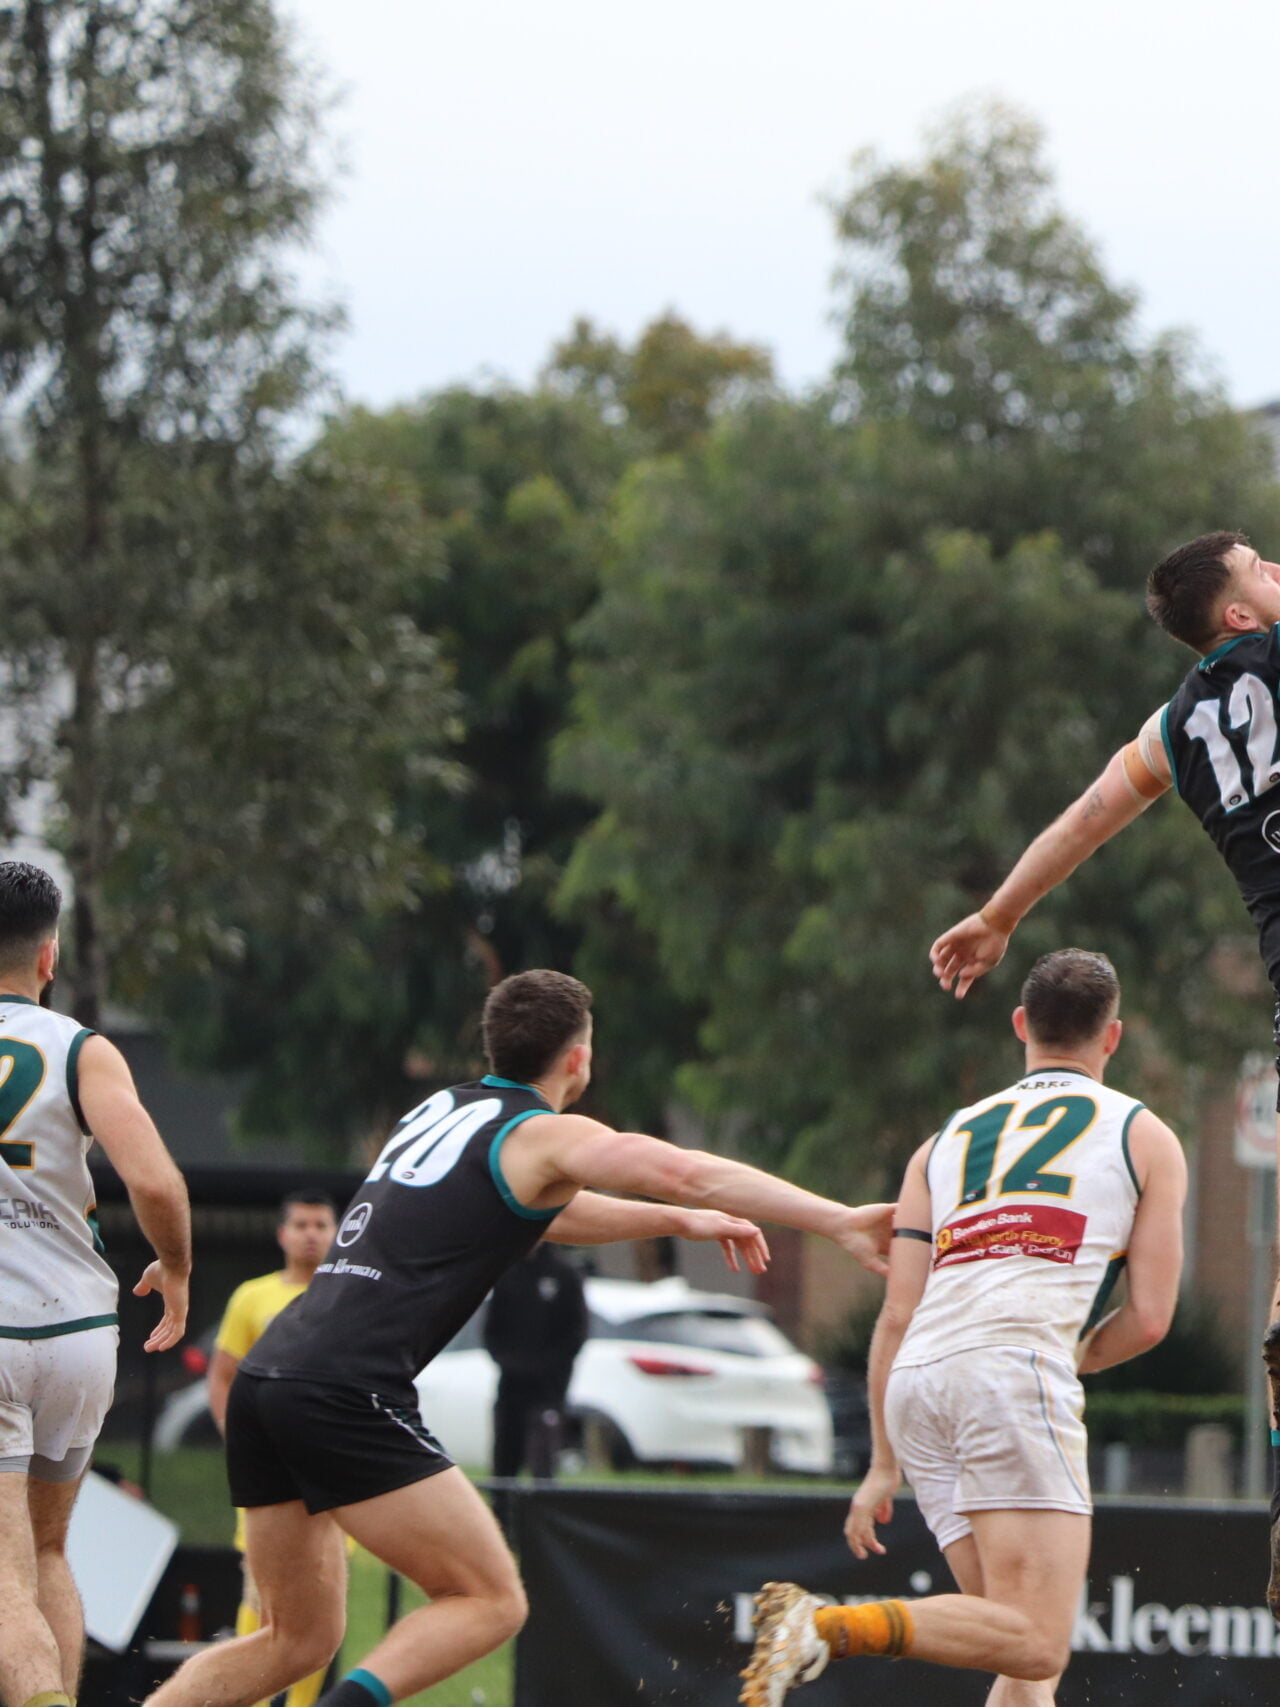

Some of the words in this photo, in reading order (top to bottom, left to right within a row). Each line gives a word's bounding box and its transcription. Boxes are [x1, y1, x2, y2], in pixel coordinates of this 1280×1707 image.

[365, 1088, 502, 1188] 20
[952, 1094, 1100, 1210] 12
[997, 1211, 1033, 1224] Bank
